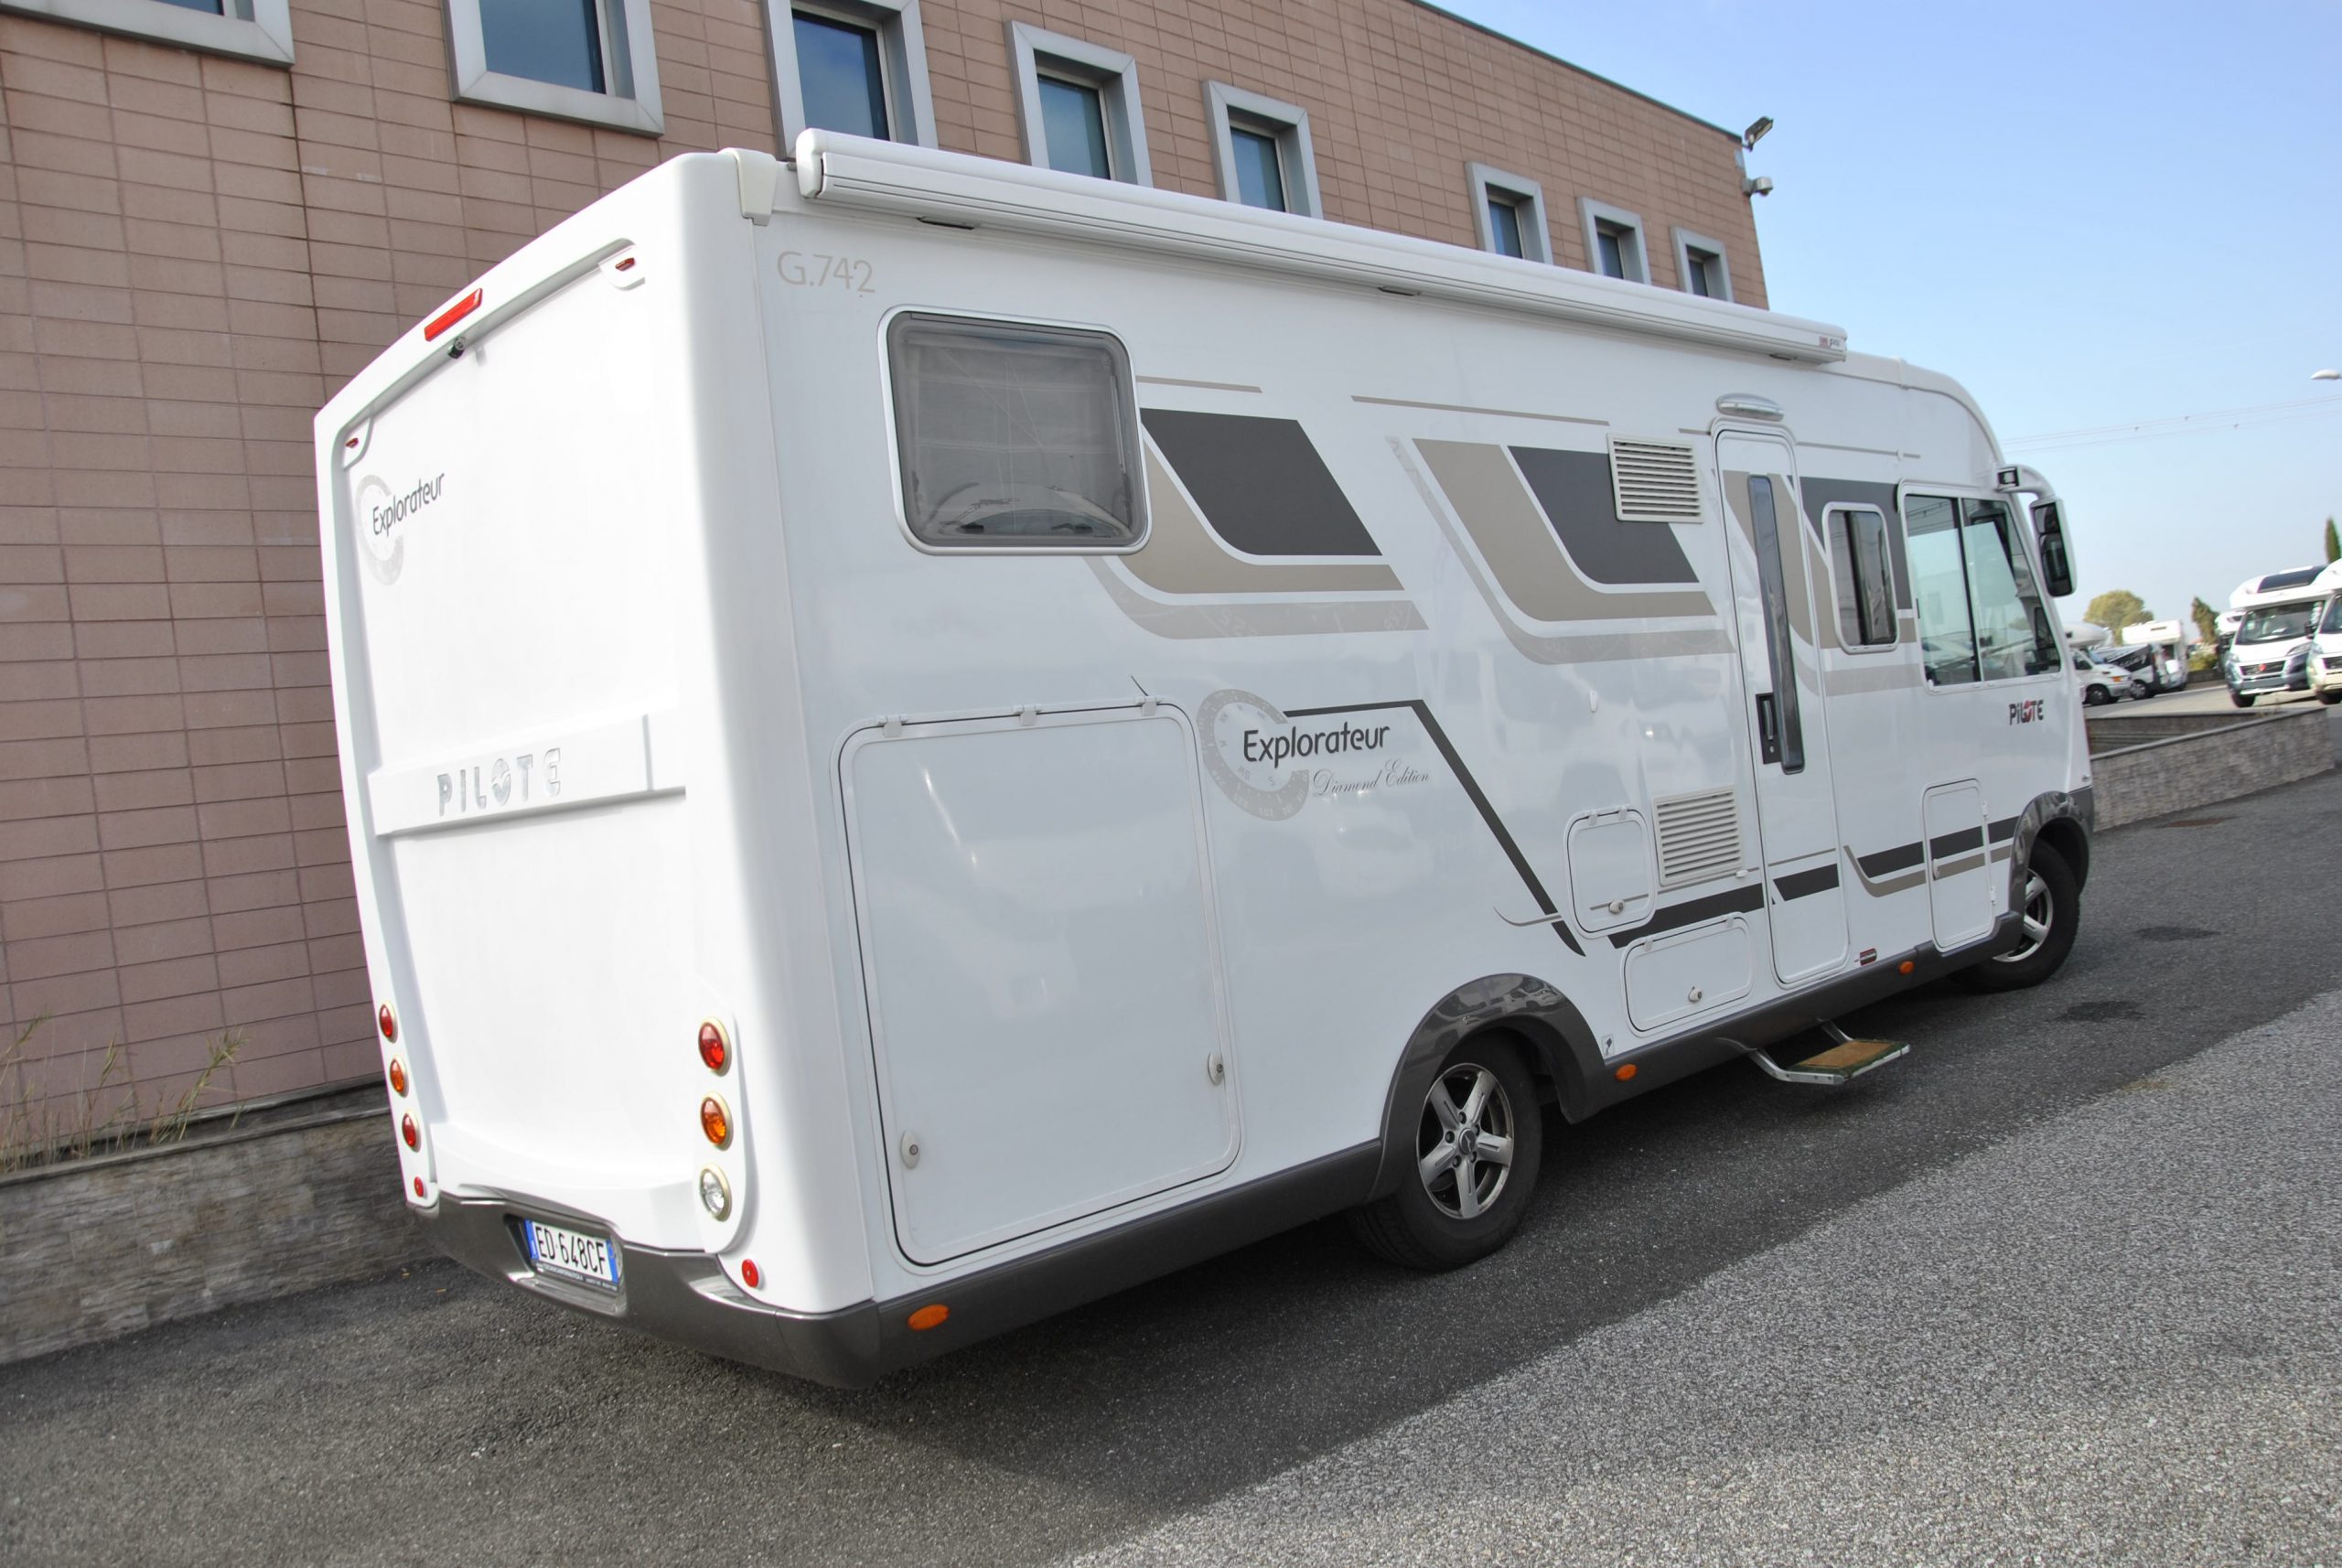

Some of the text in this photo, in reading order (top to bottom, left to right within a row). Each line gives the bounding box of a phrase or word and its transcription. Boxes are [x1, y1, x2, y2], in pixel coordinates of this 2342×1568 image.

[777, 251, 876, 293] G.742
[372, 473, 445, 538] Explorateur
[1243, 721, 1391, 768] Explorateur
[436, 747, 561, 817] PILOTE
[1313, 768, 1382, 797] Diamond
[1384, 758, 1429, 787] Edition
